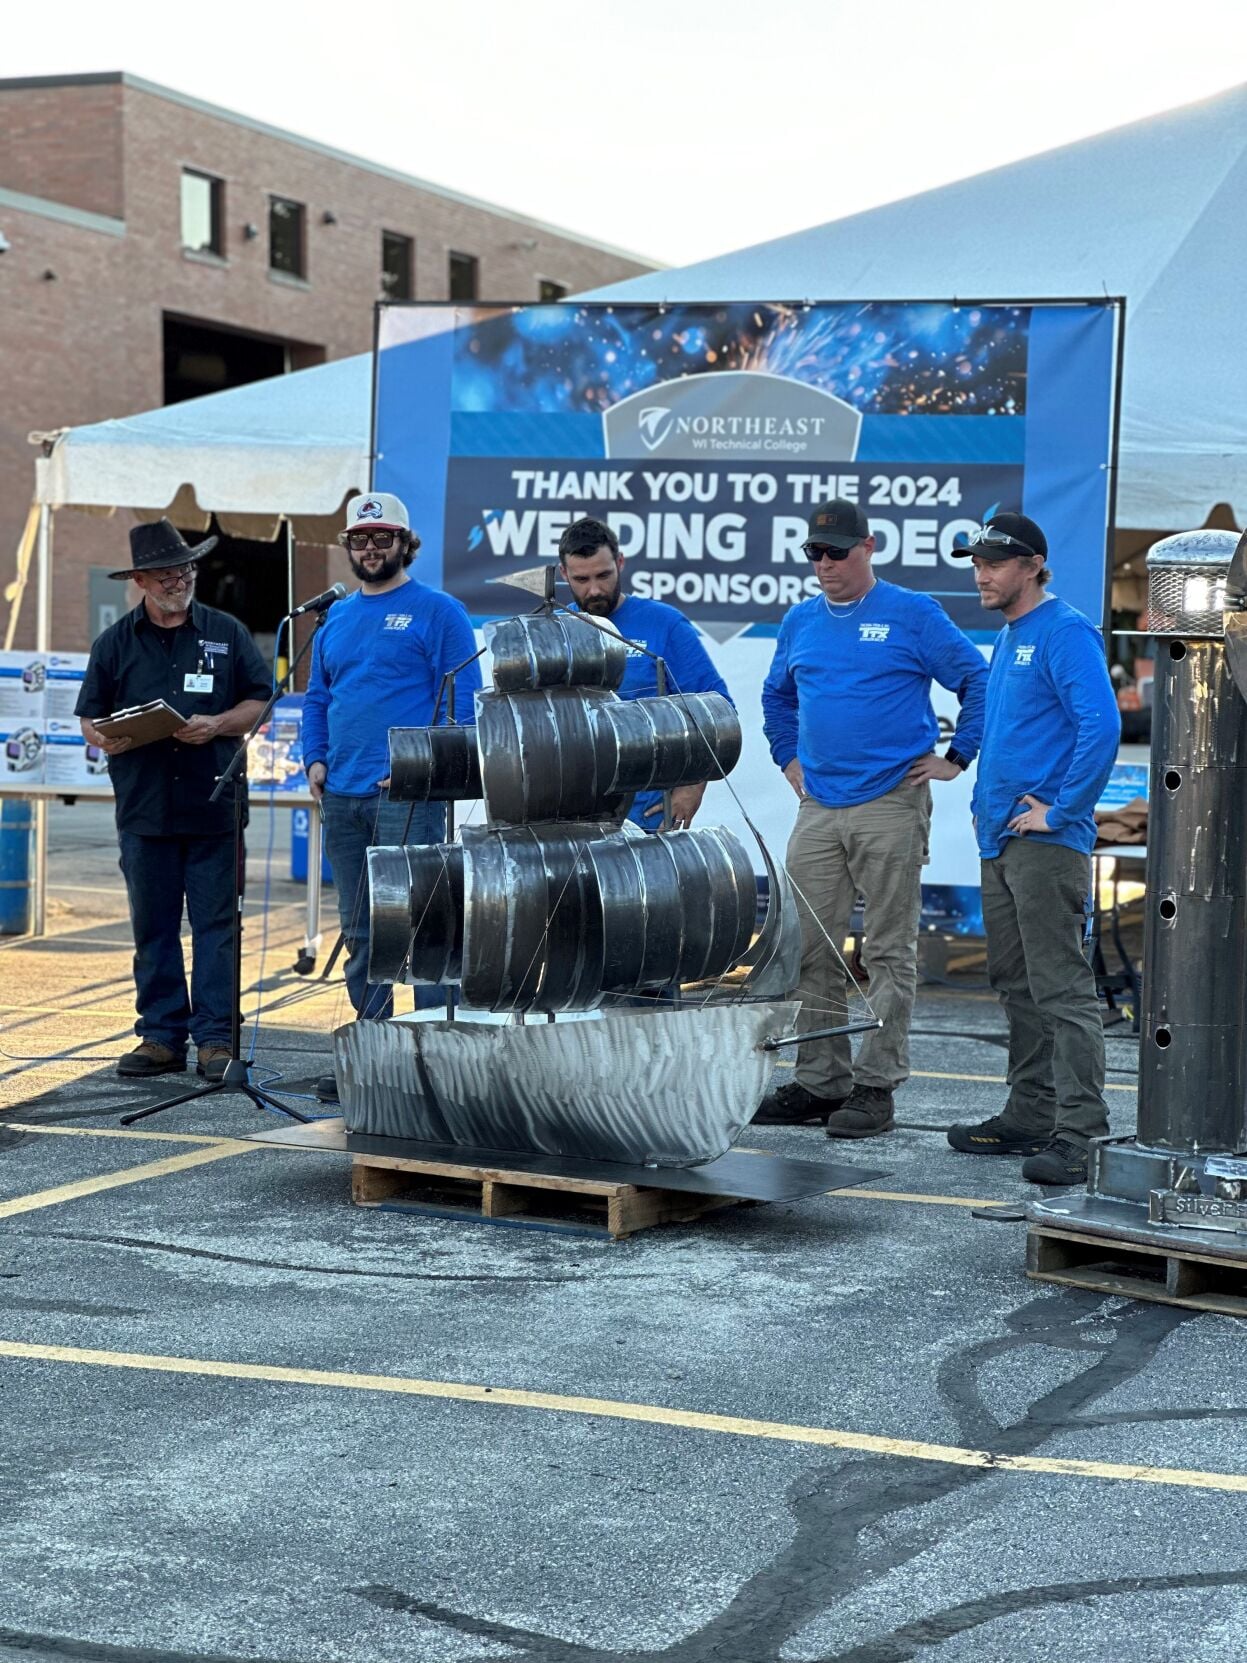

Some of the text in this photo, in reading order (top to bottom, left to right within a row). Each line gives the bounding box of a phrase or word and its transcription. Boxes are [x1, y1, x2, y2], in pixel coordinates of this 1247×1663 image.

[676, 416, 826, 436] NORTHEAST
[692, 438, 808, 453] WI Technical College
[511, 470, 963, 507] THANK YOU TO THE 2024
[482, 509, 983, 569] WEDING RDEO
[630, 570, 822, 605] SPONSORS
